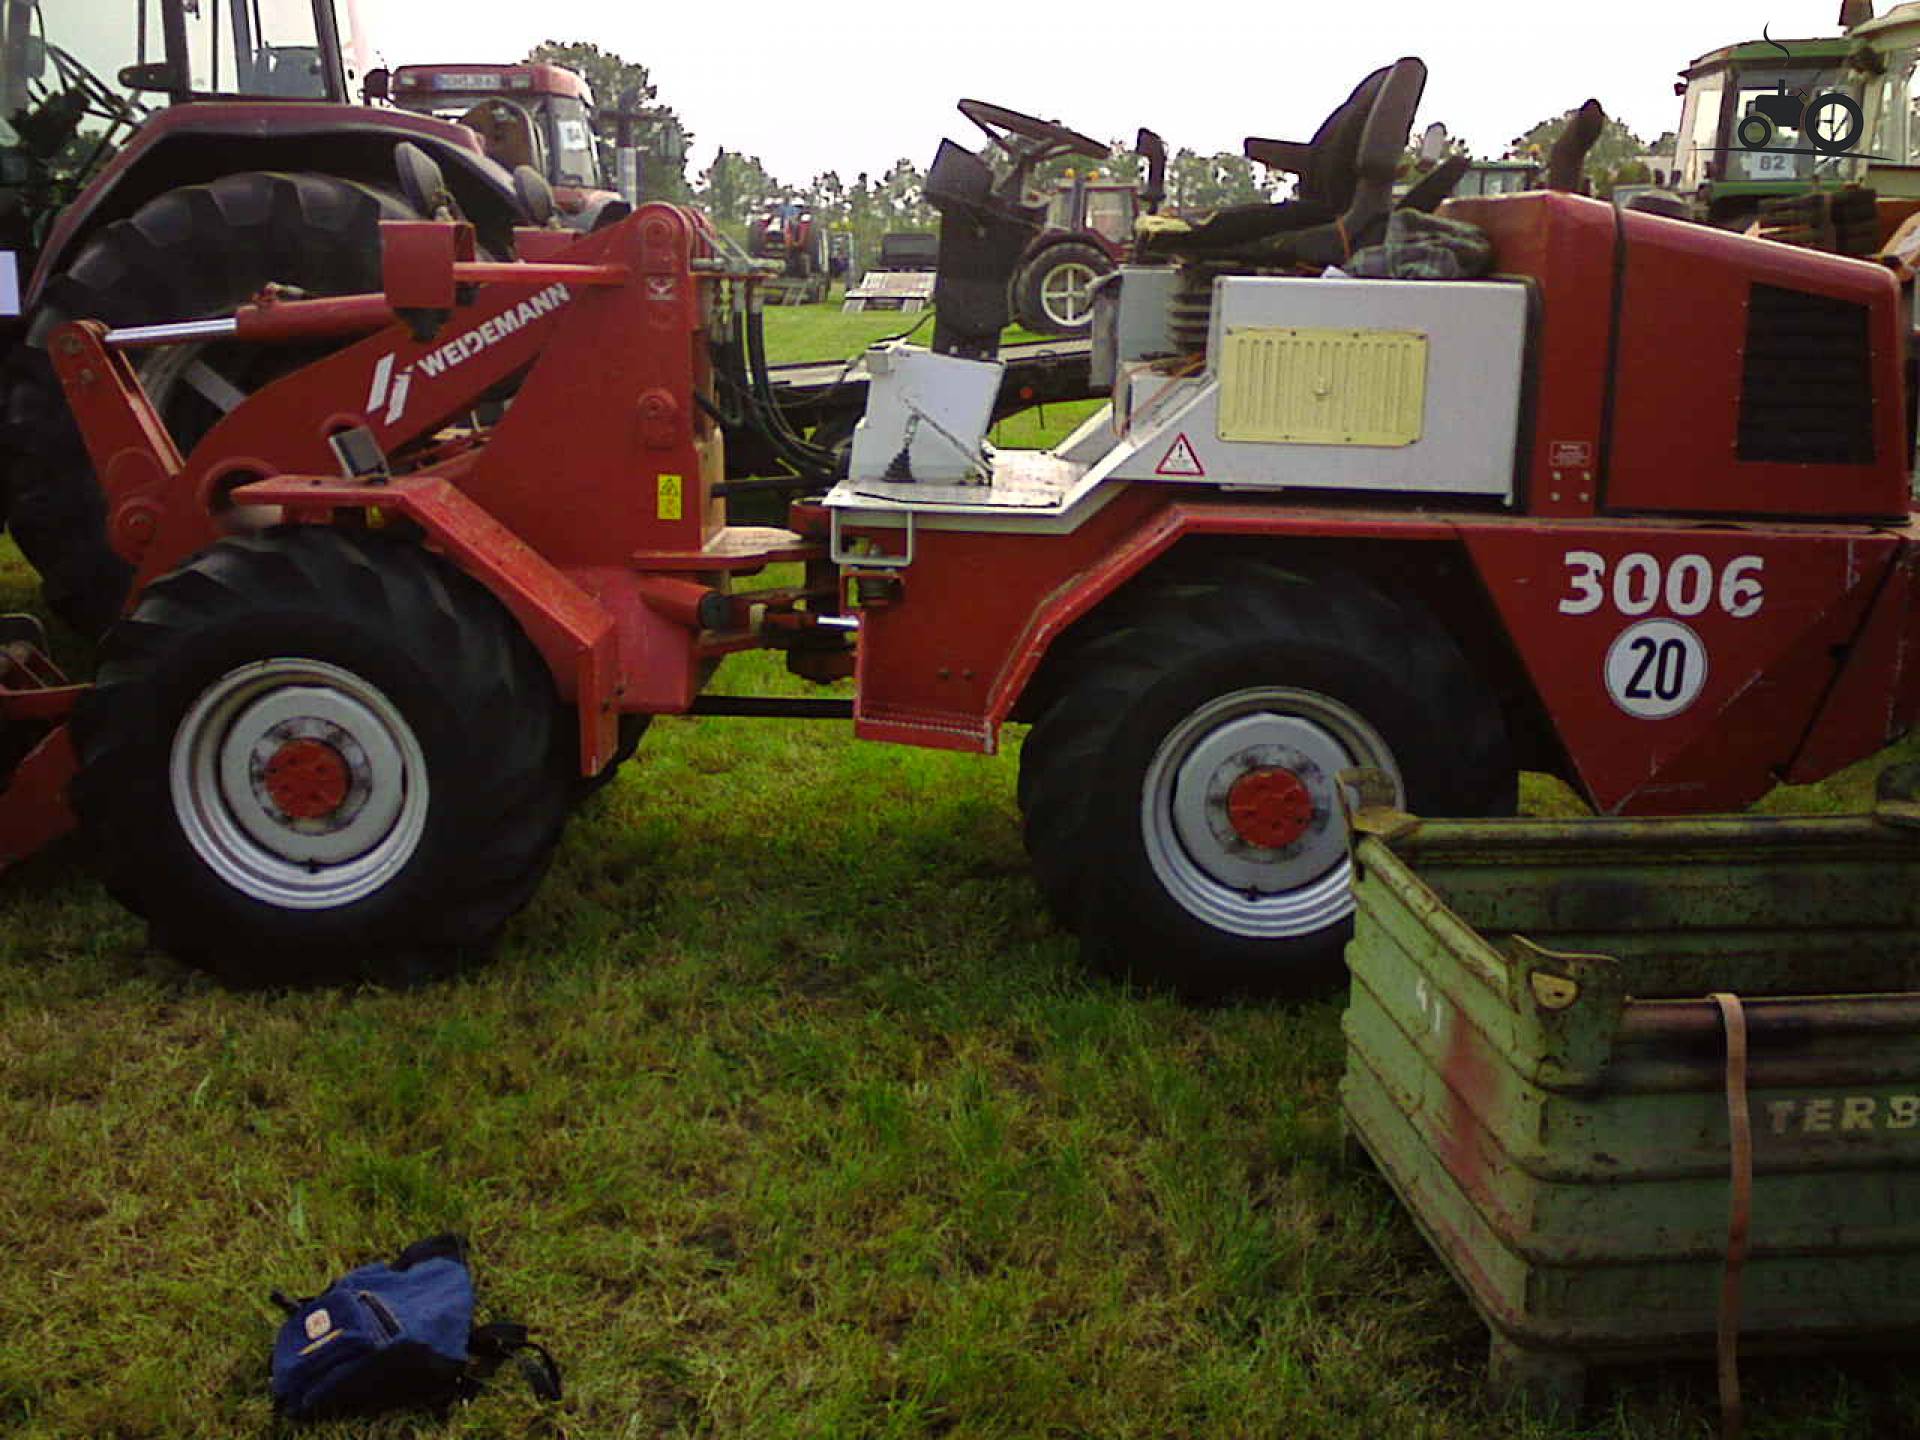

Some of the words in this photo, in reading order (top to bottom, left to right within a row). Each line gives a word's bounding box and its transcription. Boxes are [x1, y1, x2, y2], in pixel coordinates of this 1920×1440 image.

[416, 282, 571, 378] WEIDEMANN
[1558, 551, 1765, 618] 3006
[1625, 636, 1687, 701] 20
